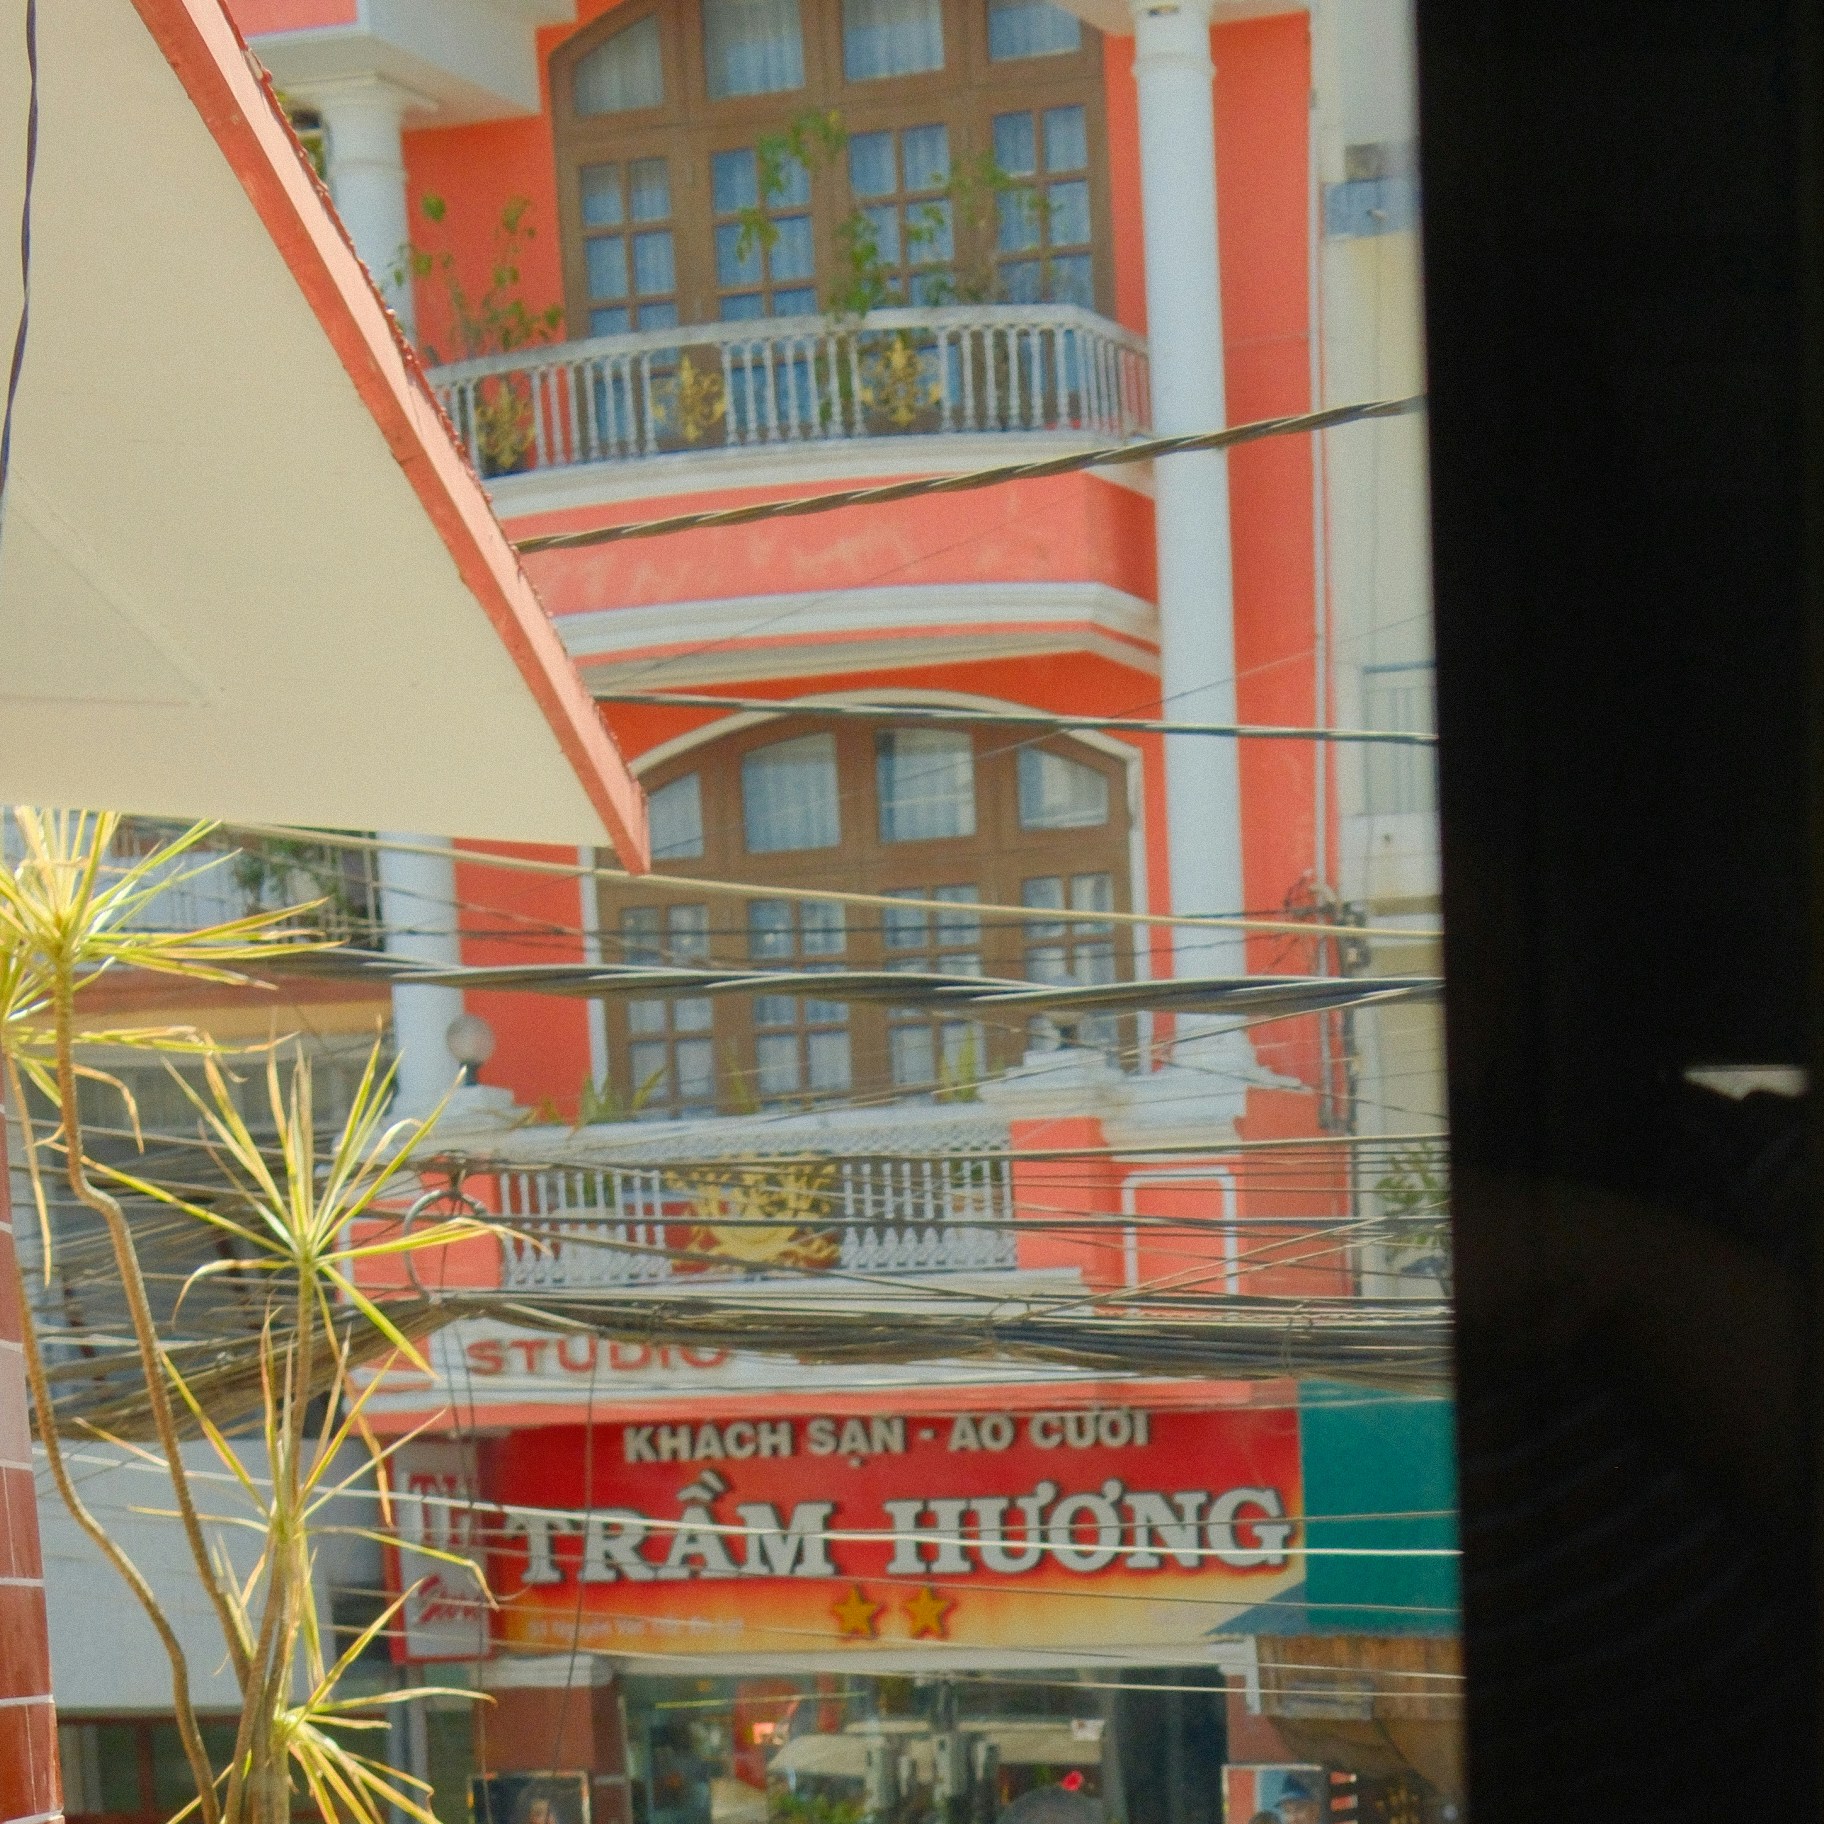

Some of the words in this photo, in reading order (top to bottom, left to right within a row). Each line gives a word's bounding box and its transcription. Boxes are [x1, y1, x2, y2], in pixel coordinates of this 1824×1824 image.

[466, 1336, 730, 1376] STUDIO
[807, 1414, 906, 1468] SẠN
[504, 1468, 837, 1584] TRẦM
[884, 1478, 1292, 1574] HƯƠNG
